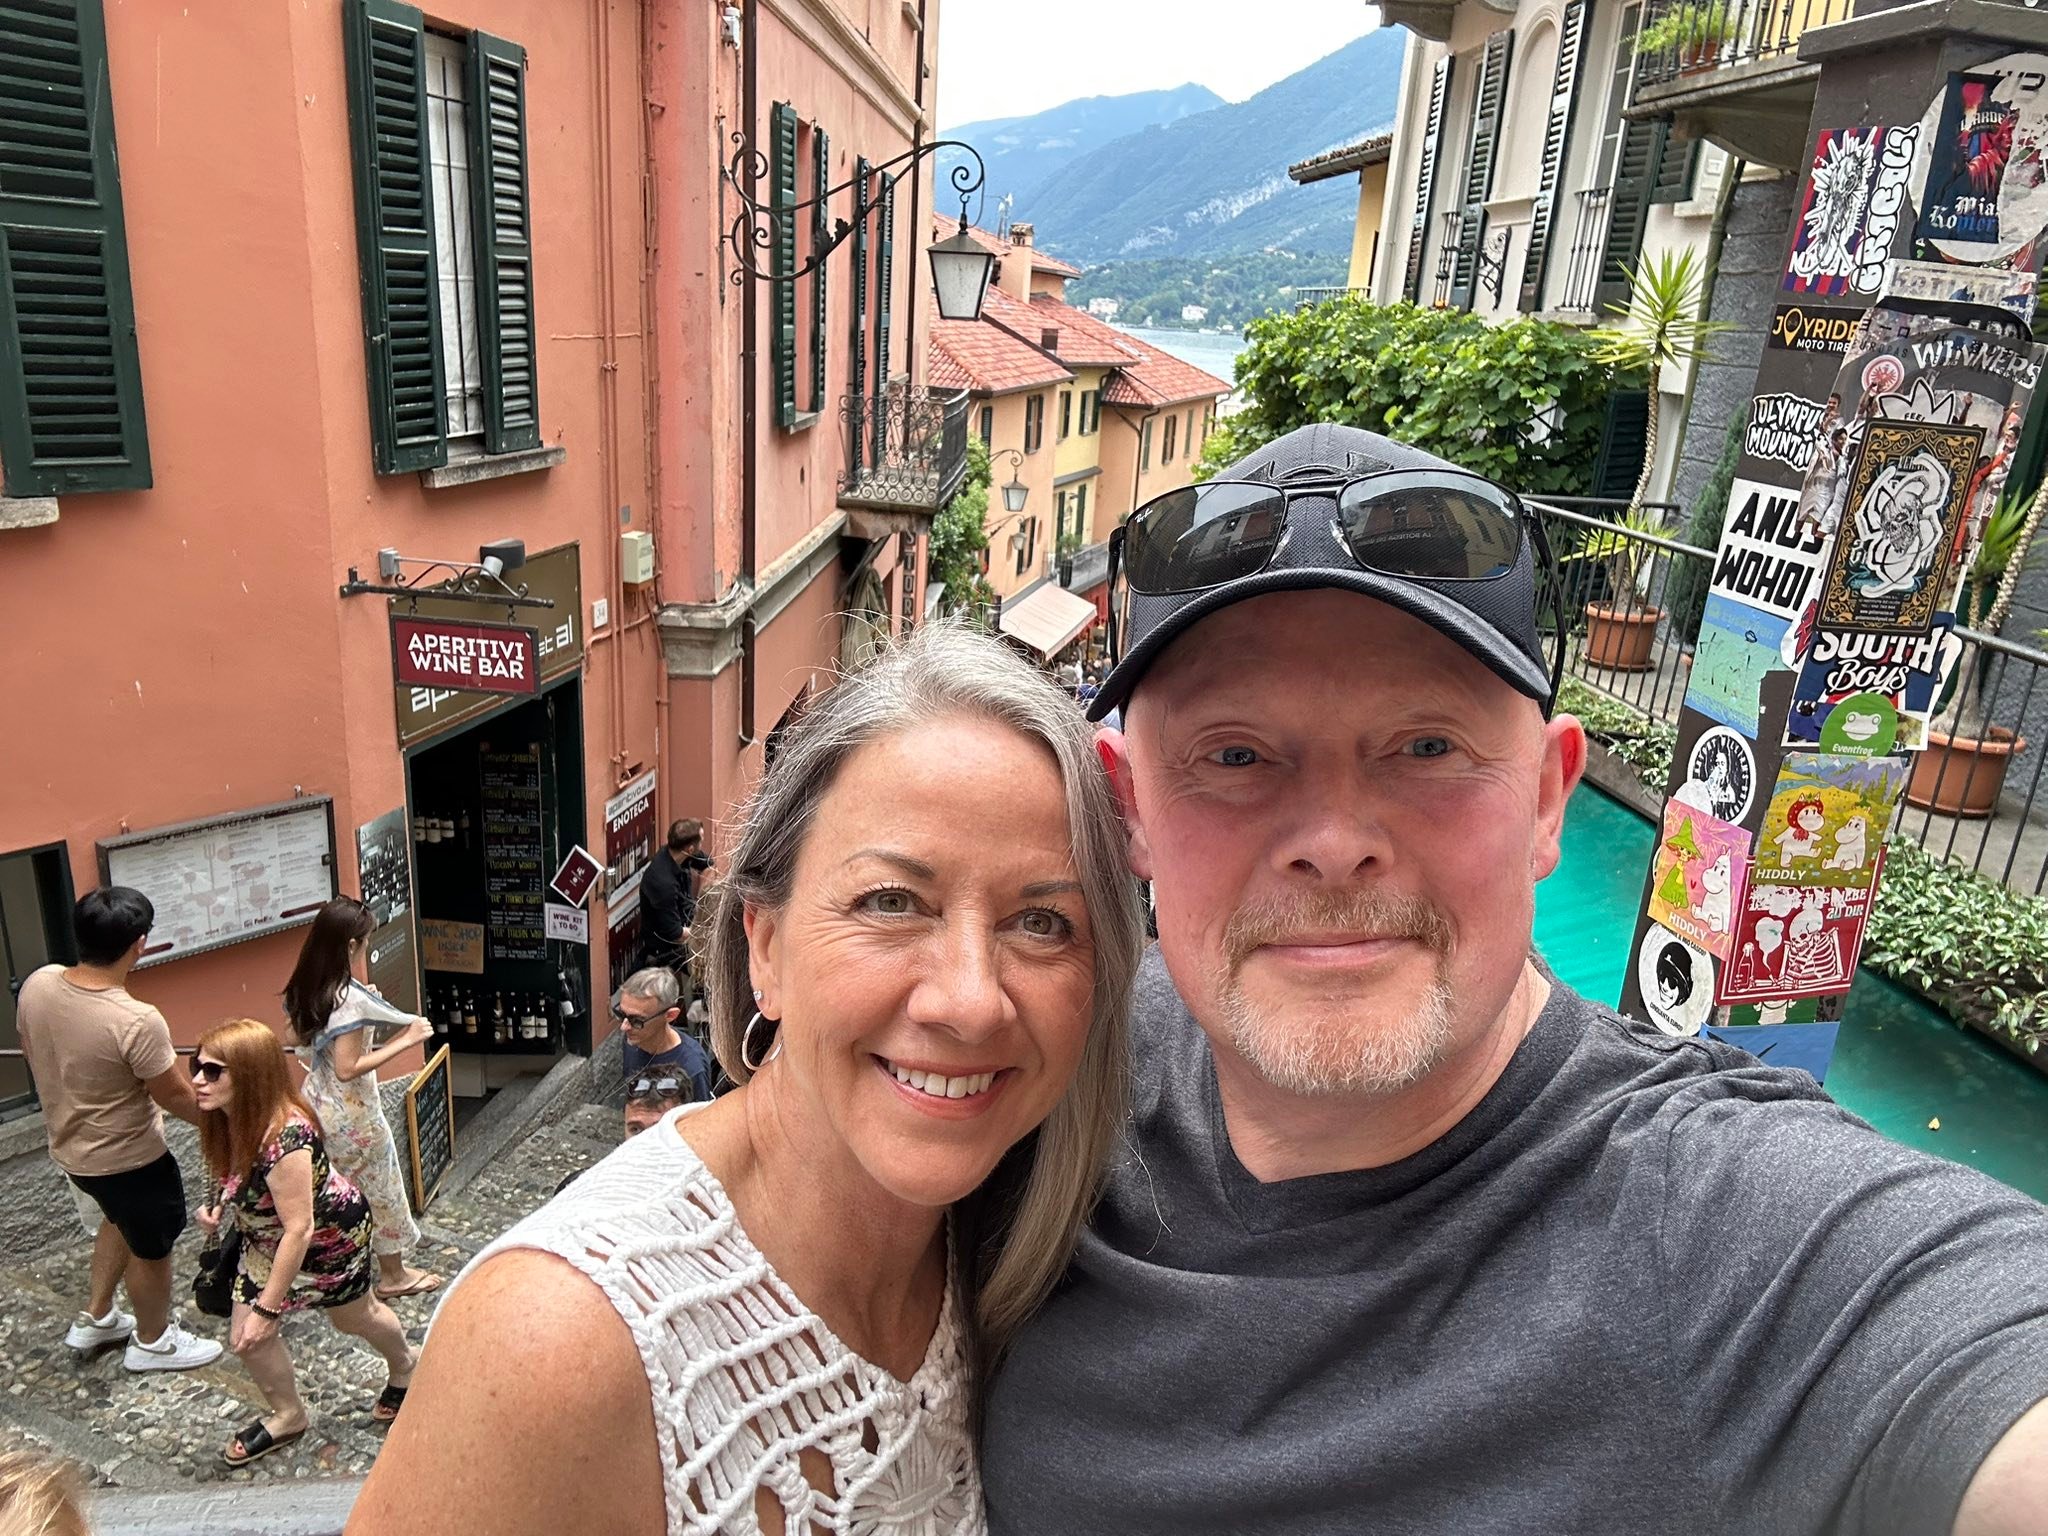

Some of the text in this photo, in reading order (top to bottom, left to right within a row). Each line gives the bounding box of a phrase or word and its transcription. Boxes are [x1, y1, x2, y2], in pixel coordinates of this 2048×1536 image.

[1796, 338, 1825, 350] MOTO
[1749, 426, 1813, 467] MOUNTAI
[407, 632, 525, 661] APERITIVI
[409, 651, 525, 680] WINE BAR
[1827, 659, 1910, 694] Boys
[613, 797, 649, 833] ENOTECA
[1755, 868, 1807, 880] HIDDLY
[553, 913, 569, 921] WINE
[1669, 911, 1708, 942] HIDDLY
